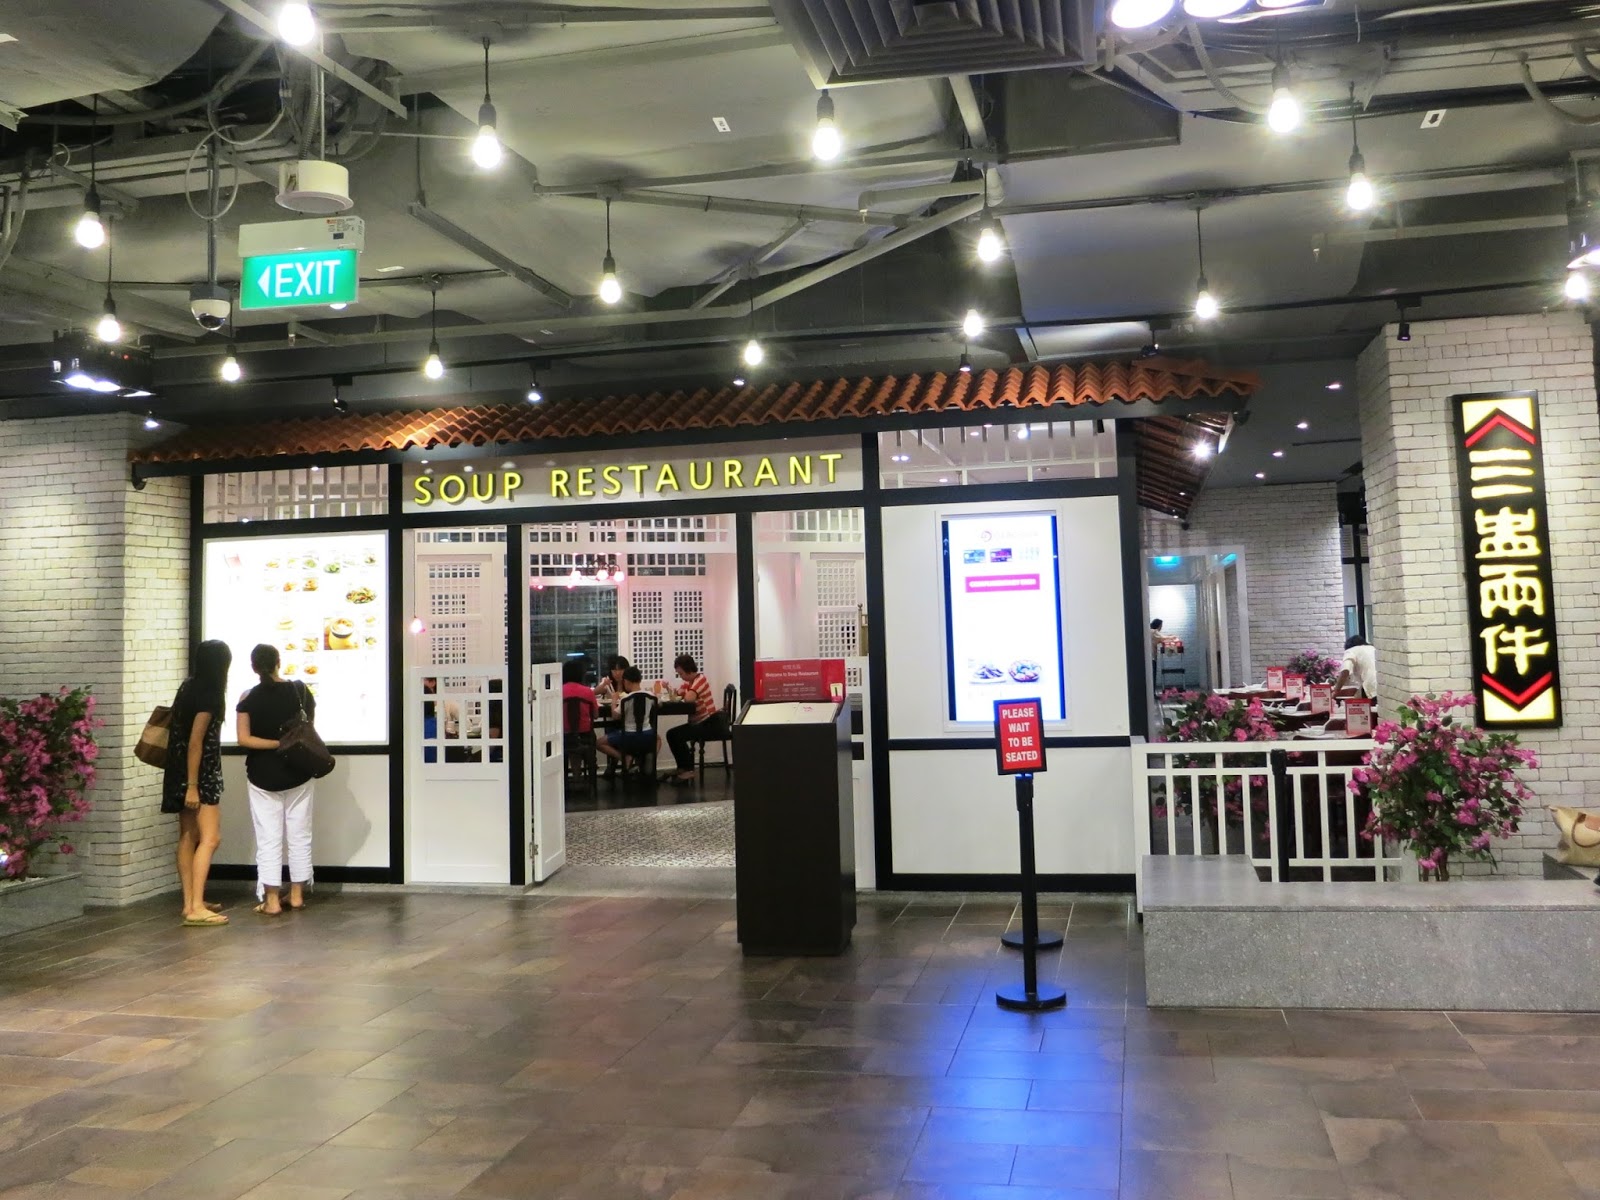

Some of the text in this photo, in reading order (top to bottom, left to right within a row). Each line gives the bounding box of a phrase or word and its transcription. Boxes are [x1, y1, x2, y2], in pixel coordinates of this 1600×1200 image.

[275, 260, 341, 298] EXIT
[414, 453, 842, 505] SOUP RESTAURANT
[1002, 708, 1034, 719] PLEASE
[1008, 722, 1030, 733] WAIT
[1008, 736, 1033, 747] TO BE
[1005, 750, 1038, 762] SEATED
